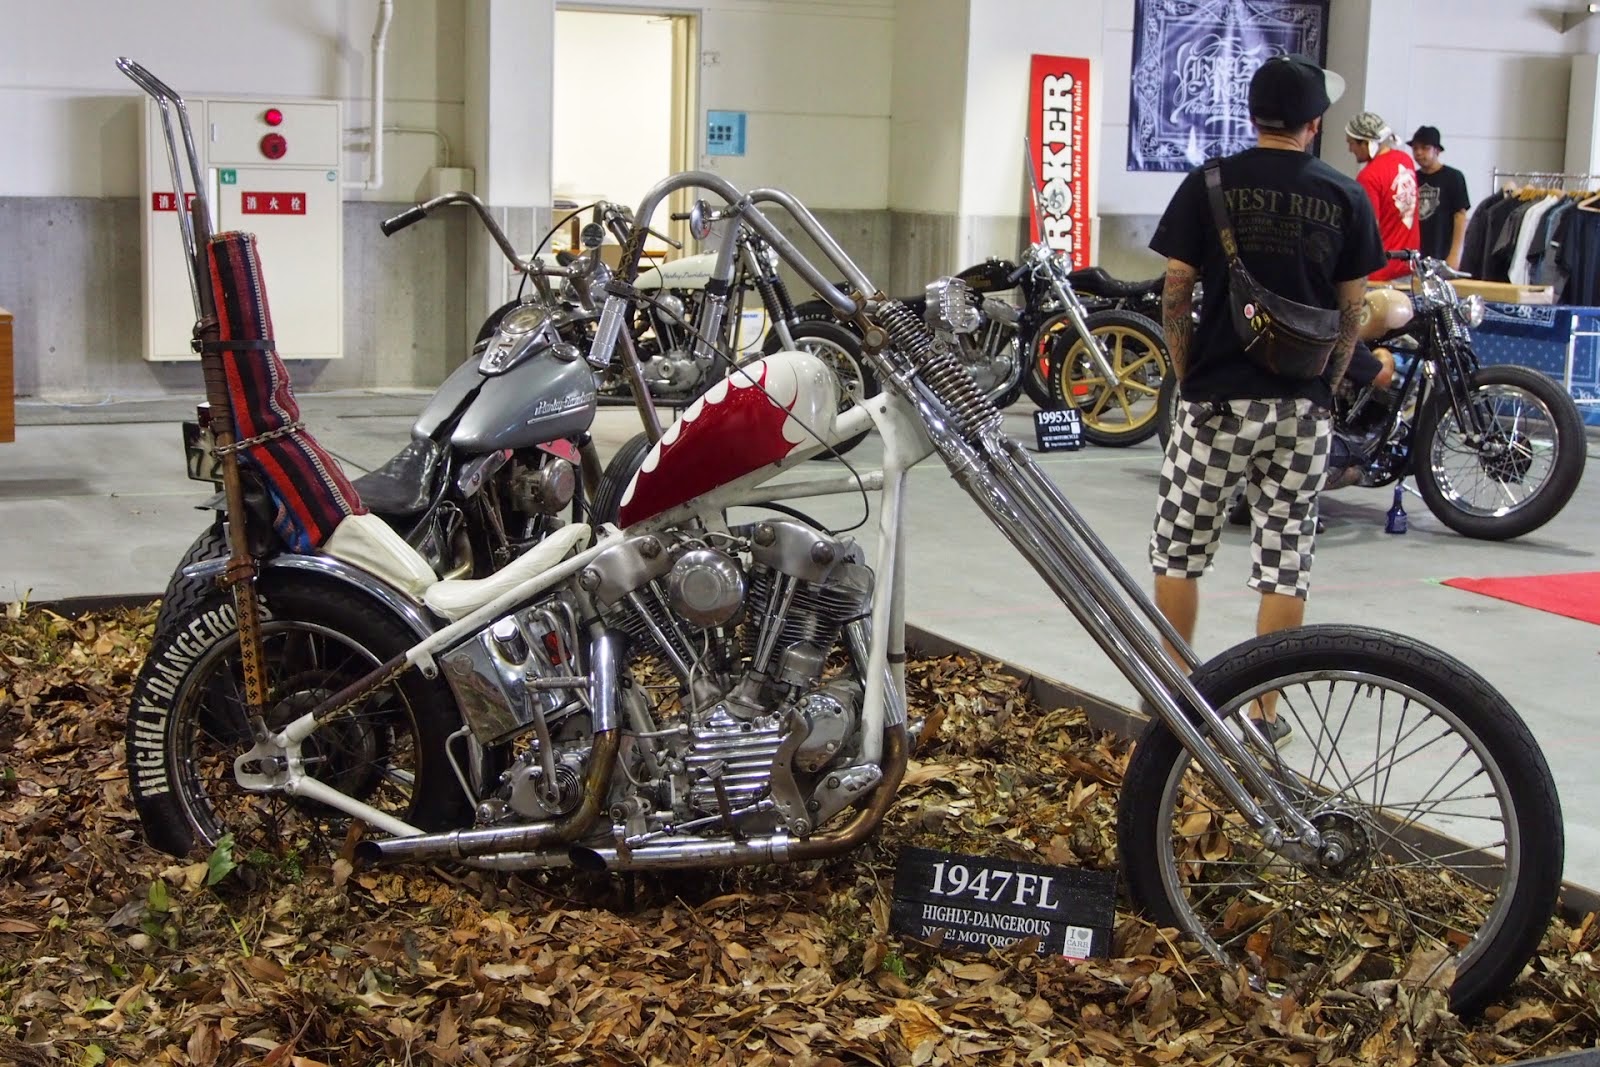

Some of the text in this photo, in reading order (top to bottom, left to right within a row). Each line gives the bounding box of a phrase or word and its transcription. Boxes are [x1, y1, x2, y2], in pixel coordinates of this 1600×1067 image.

[1073, 80, 1084, 267] For Harley Davidson Parts And Any Vehicle
[247, 197, 301, 210] 消火栓
[1289, 193, 1342, 228] RIDE
[1037, 409, 1079, 425] 1995XL
[134, 594, 273, 797] HIGHLY-DANGEROS
[929, 862, 1059, 910] 1947FL
[921, 926, 955, 940] NIE!
[922, 904, 1051, 936] HIGHLY-DANGEROUS
